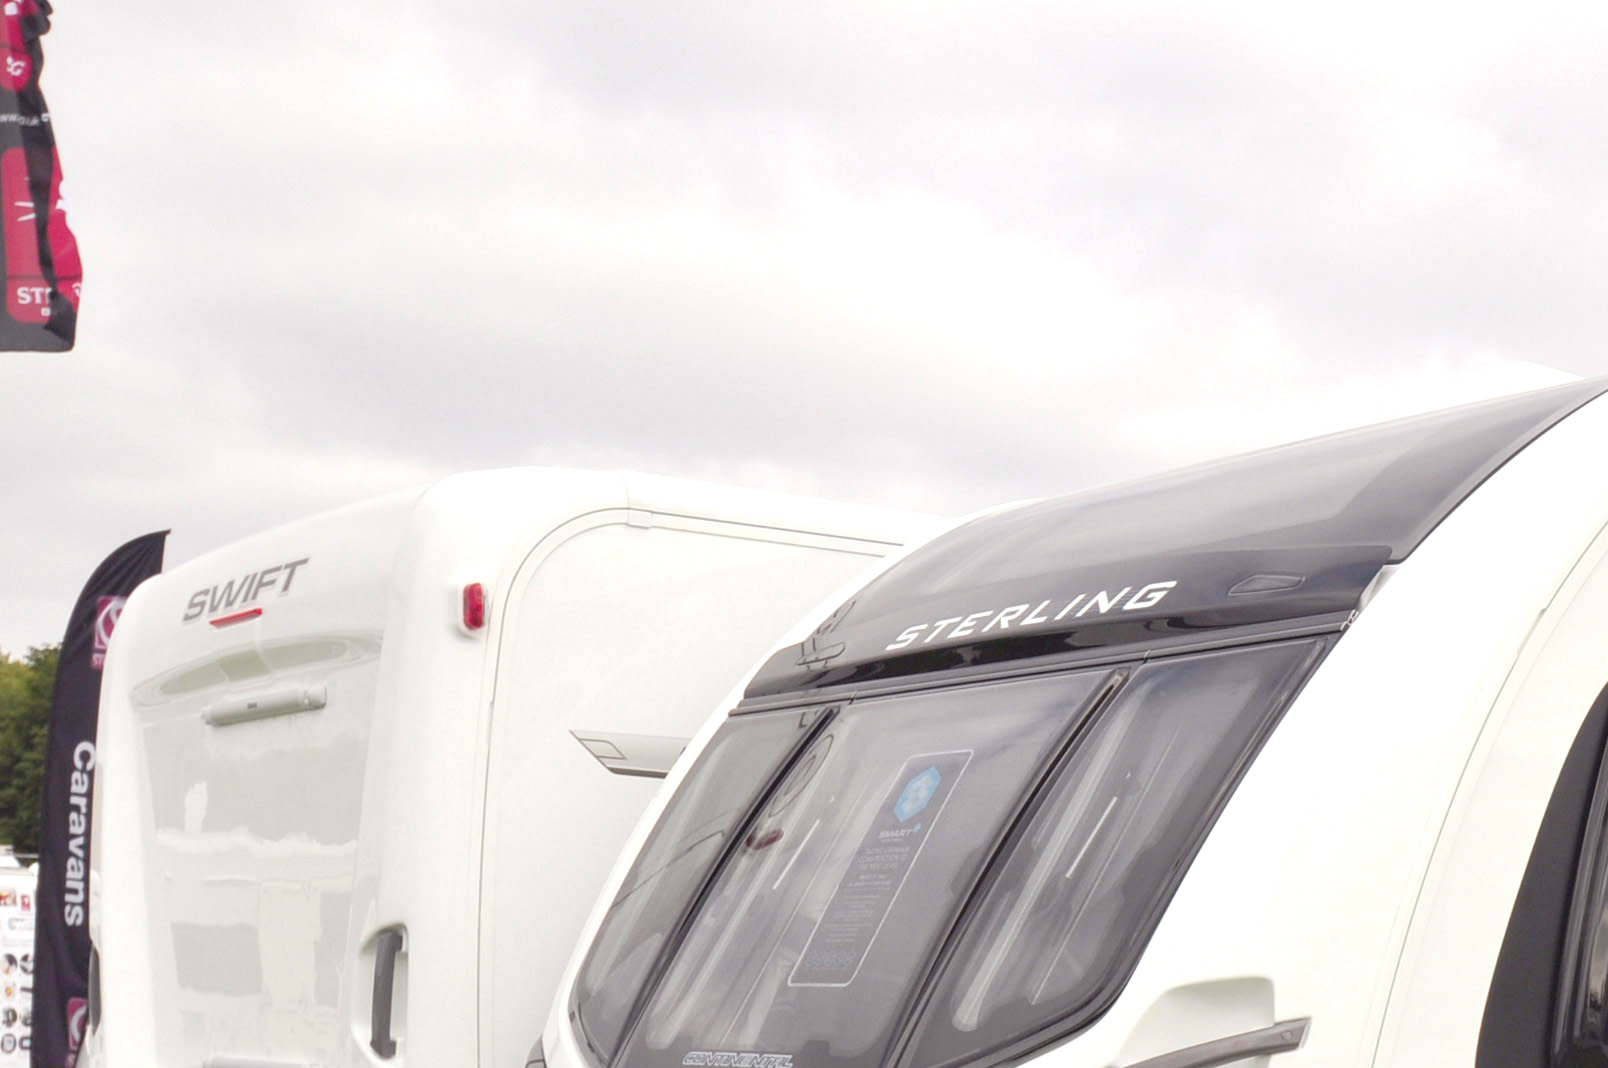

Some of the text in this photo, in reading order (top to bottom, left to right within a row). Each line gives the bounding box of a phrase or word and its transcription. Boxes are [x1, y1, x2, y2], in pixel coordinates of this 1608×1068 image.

[182, 557, 310, 624] SWIFT
[885, 580, 1178, 651] STERLING
[64, 740, 96, 927] Caravans
